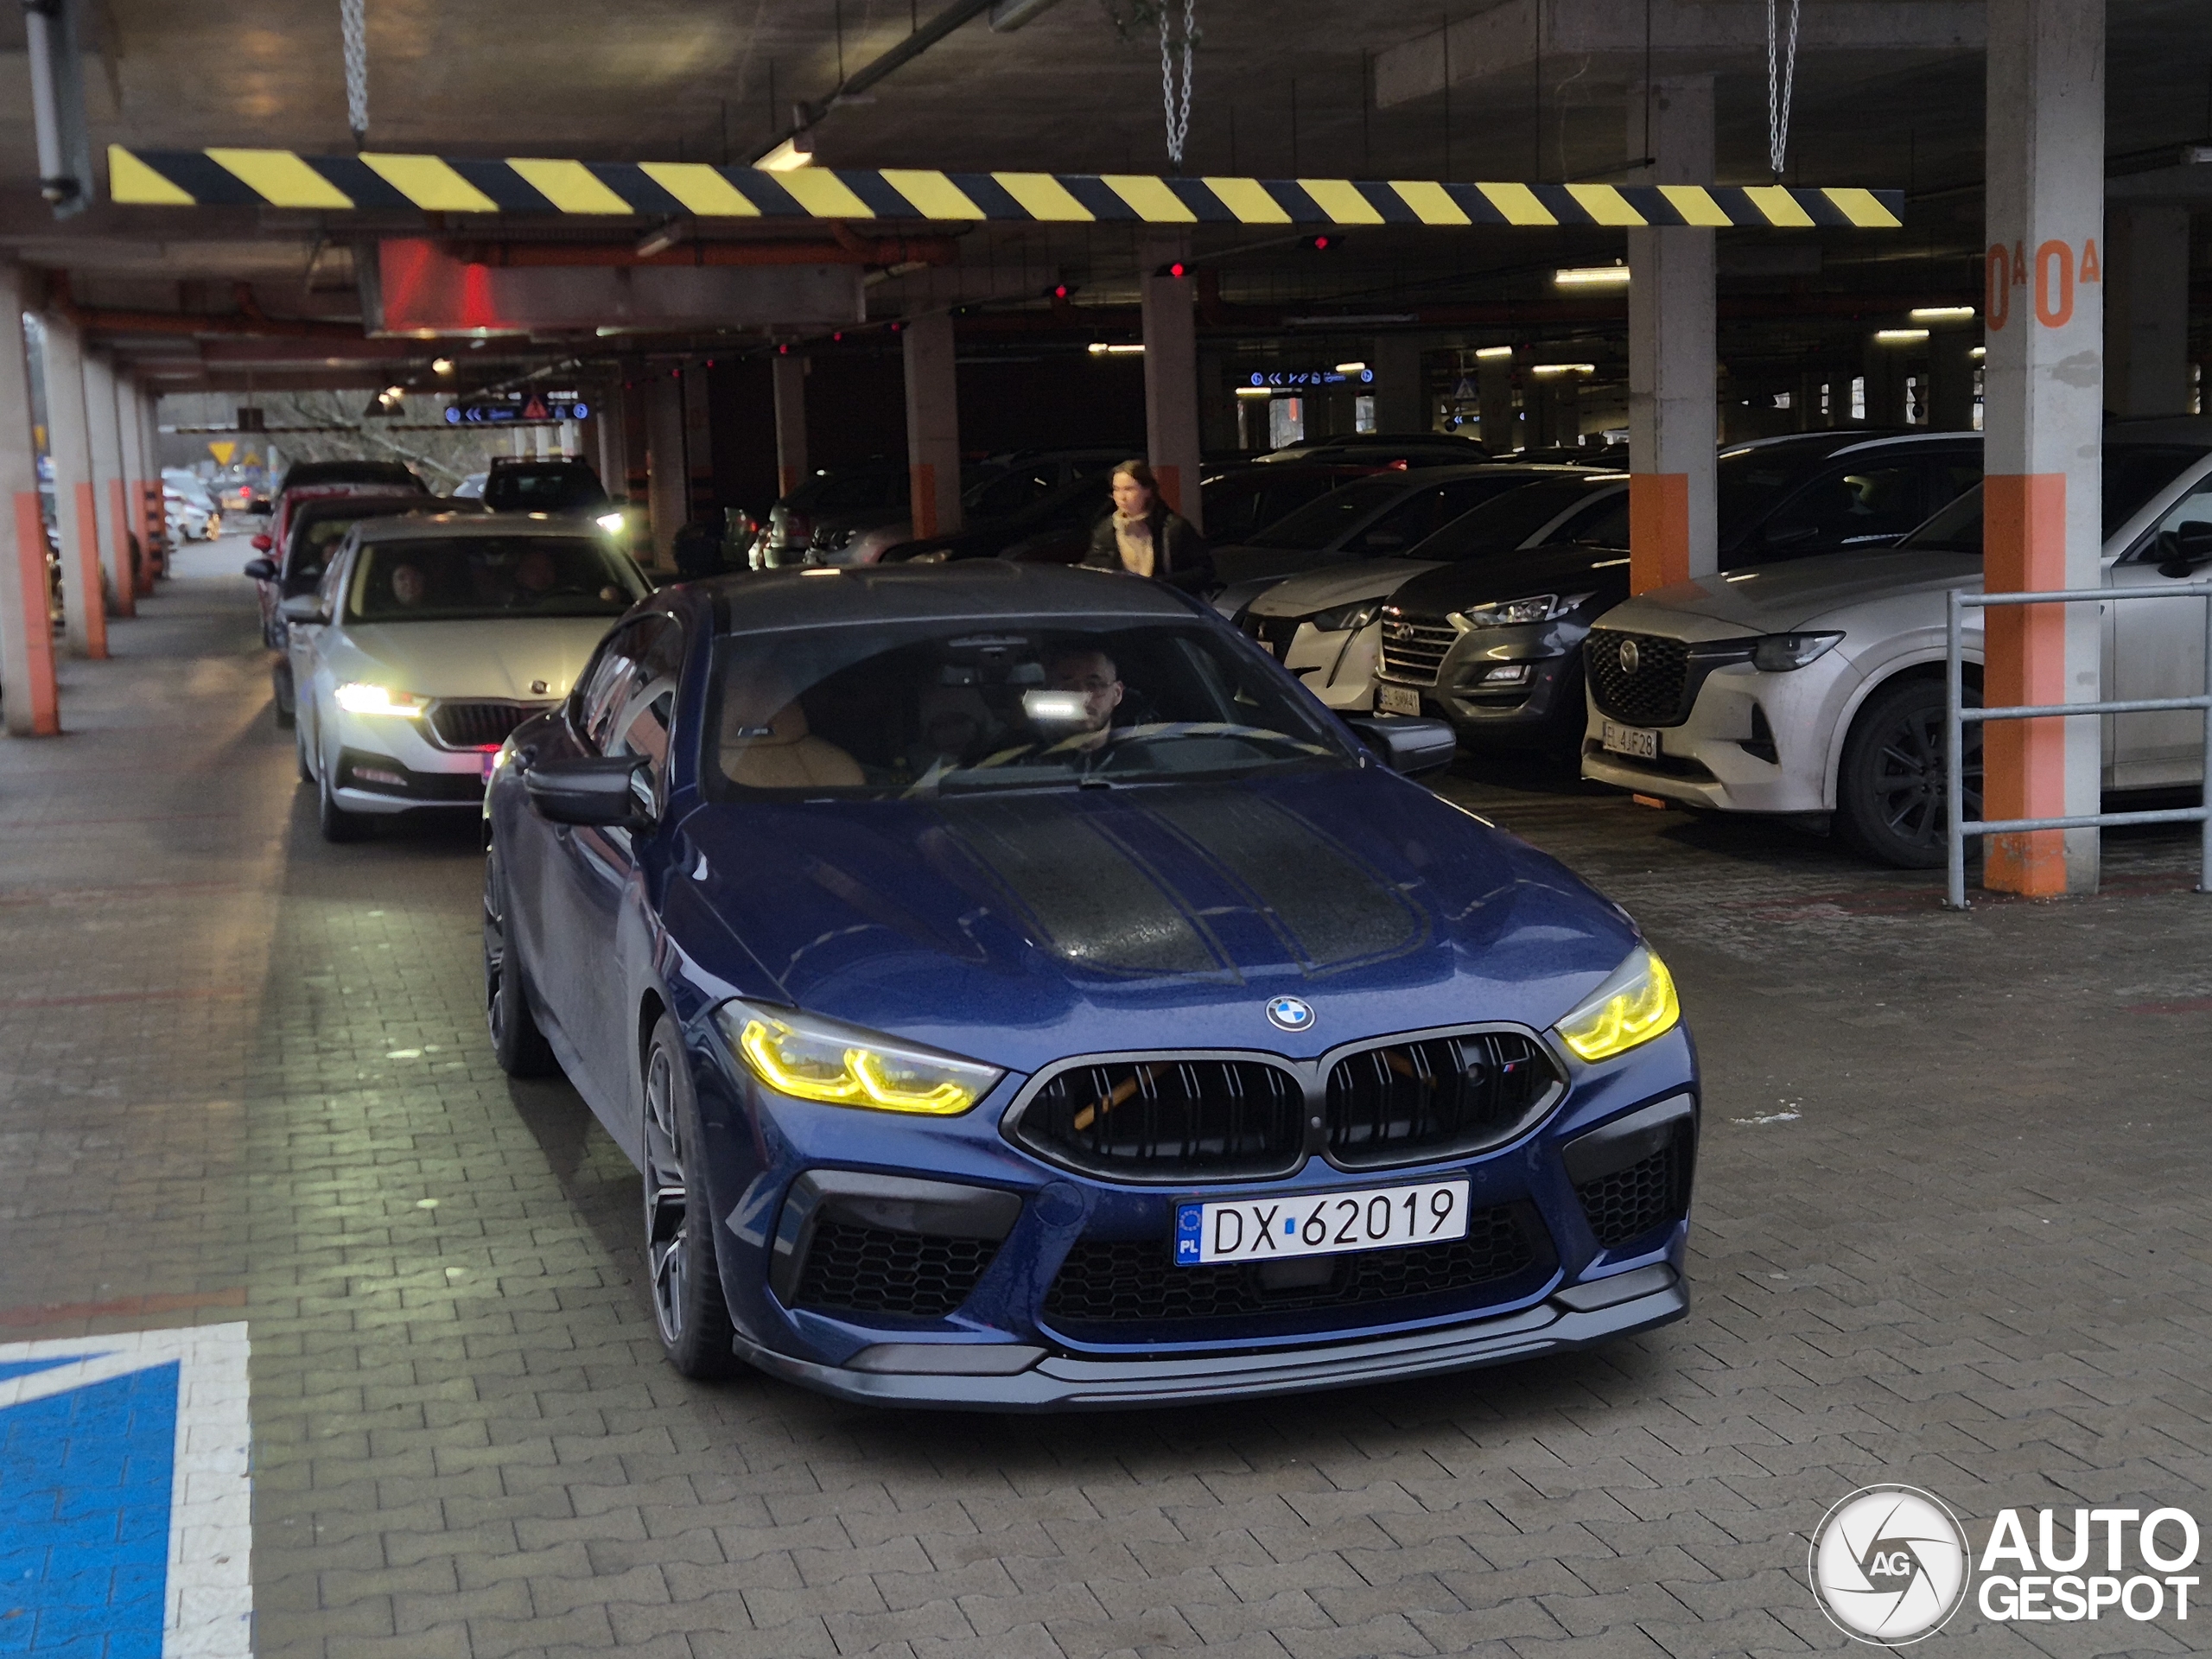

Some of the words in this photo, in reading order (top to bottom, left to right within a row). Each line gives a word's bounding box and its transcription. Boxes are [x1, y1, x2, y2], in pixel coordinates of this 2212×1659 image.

[1214, 1205, 1279, 1255] DX
[1302, 1188, 1454, 1246] 62019
[1179, 1240, 1198, 1254] PL
